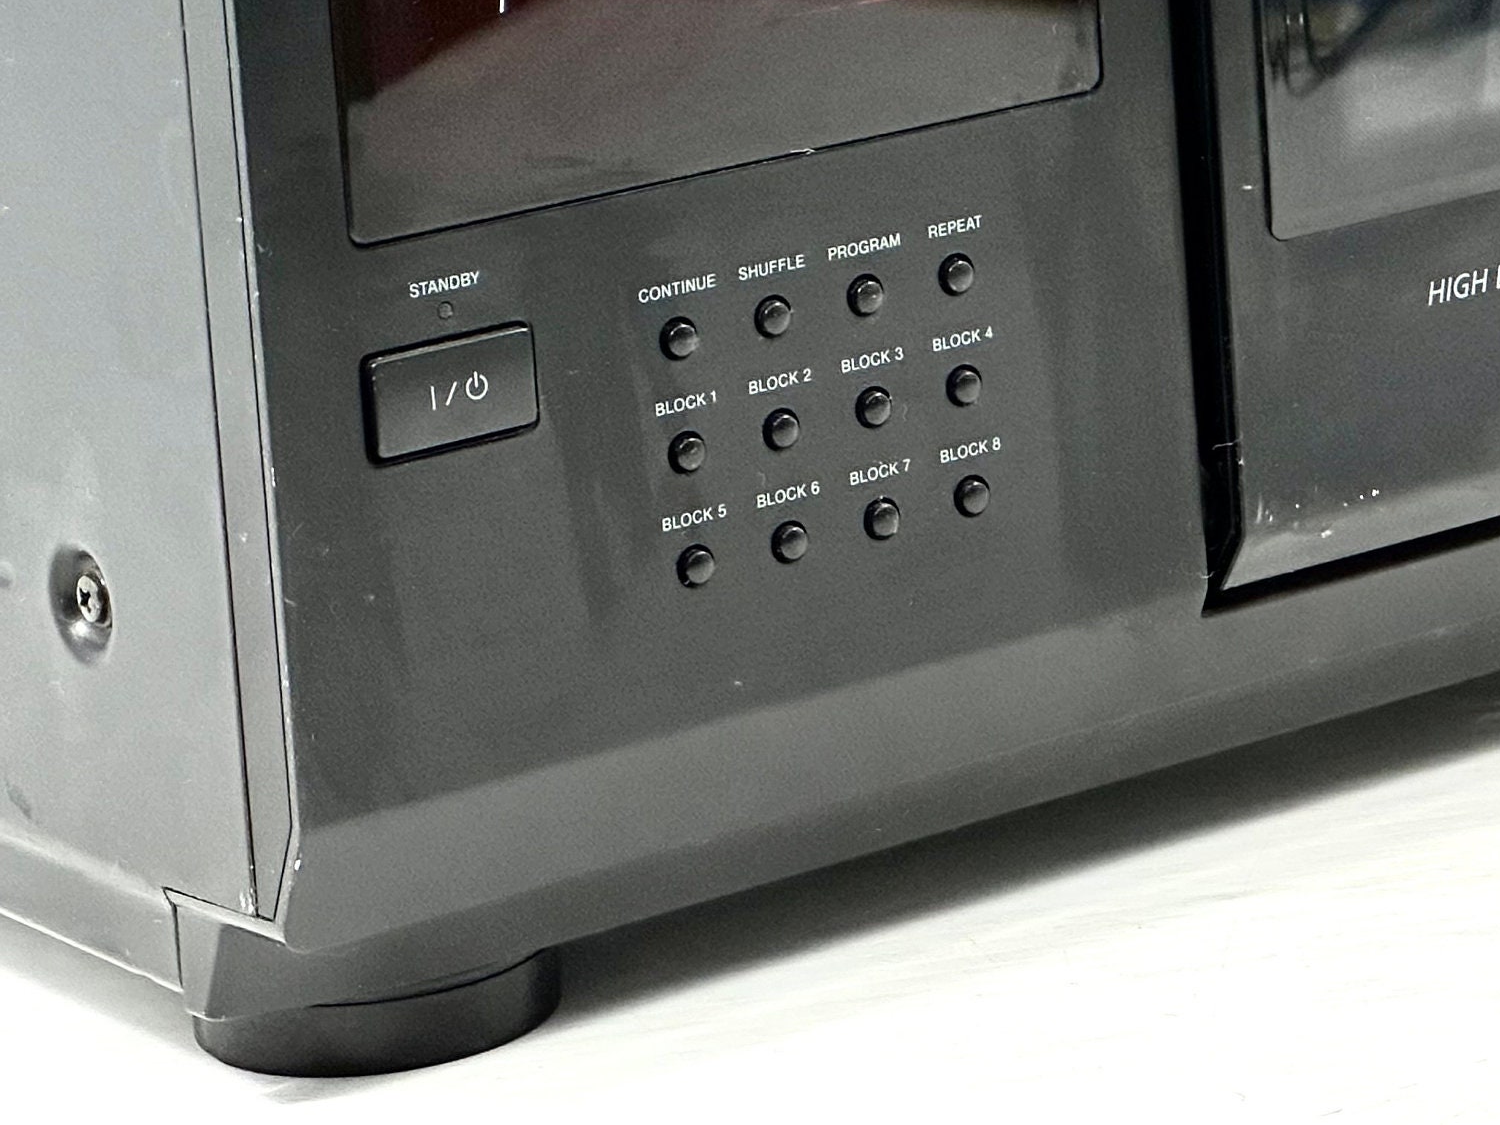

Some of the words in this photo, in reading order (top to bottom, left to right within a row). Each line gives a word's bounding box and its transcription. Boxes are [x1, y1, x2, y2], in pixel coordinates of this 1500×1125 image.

[927, 214, 984, 240] REPEAT
[827, 232, 902, 262] PROGRAM
[737, 253, 807, 282] SHUFFLE
[408, 270, 481, 300] STANDBY
[637, 273, 717, 305] CONTINUE
[1427, 268, 1489, 307] HIGH
[932, 329, 982, 352] BLOCK
[984, 326, 994, 340] 4
[841, 350, 891, 374] BLOCK
[894, 346, 904, 362] 3
[748, 371, 798, 395] BLOCK
[802, 367, 813, 382] 2
[654, 395, 706, 417] BLOCK
[709, 390, 718, 404] 1
[939, 440, 988, 464] BLOCK
[990, 436, 1002, 452] 8
[849, 463, 900, 487] BLOCK
[902, 458, 912, 473] 7
[756, 485, 807, 509] BLOCK
[810, 481, 821, 496] 6
[661, 508, 713, 533] BLOCK
[716, 503, 728, 519] 5
